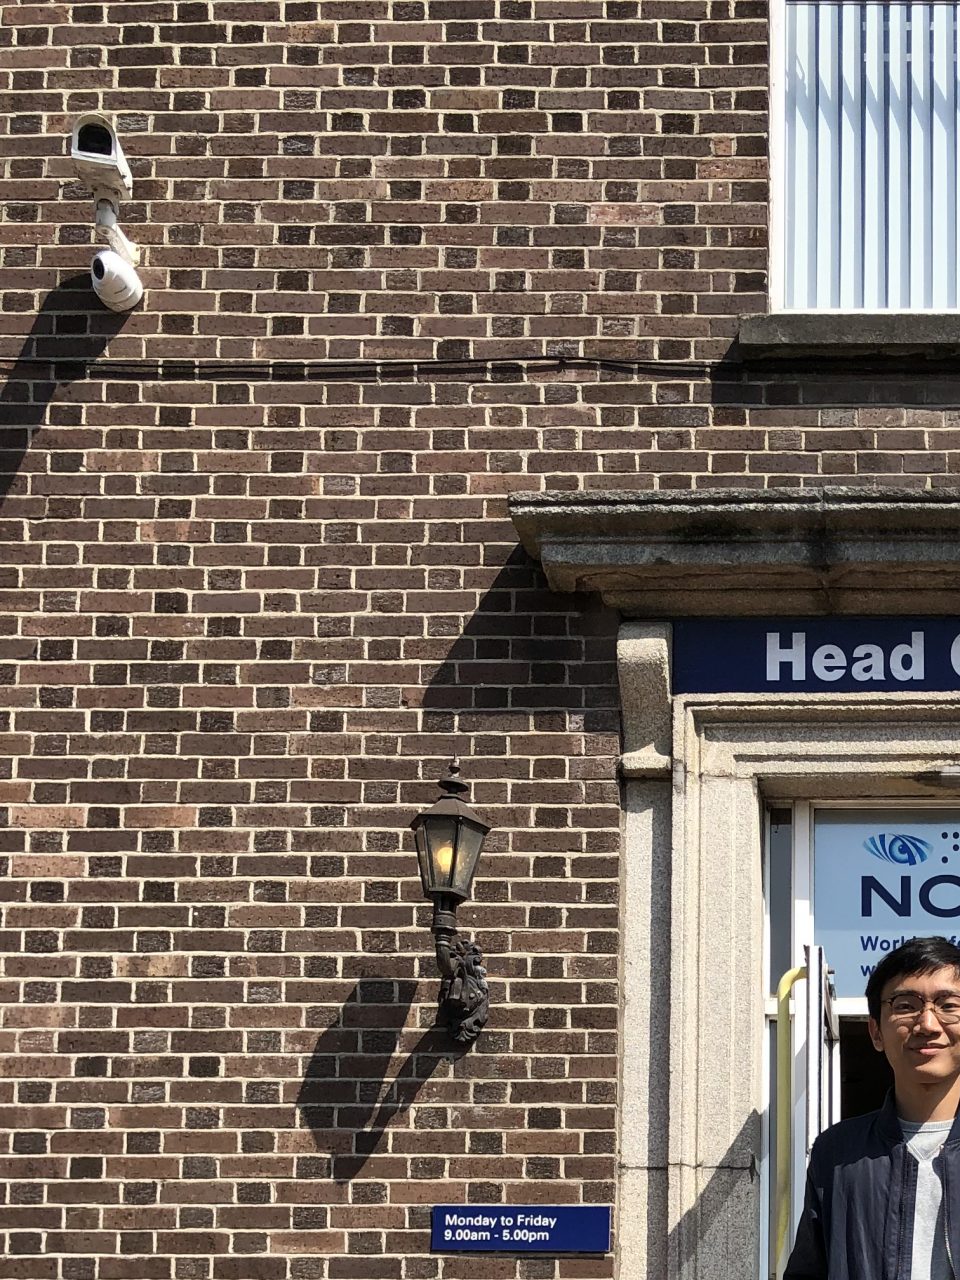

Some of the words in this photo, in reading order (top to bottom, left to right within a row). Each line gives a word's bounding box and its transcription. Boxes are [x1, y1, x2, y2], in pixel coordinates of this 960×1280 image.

[766, 631, 926, 681] Head
[445, 1214, 497, 1228] Monday
[500, 1216, 513, 1226] to
[517, 1214, 557, 1228] Friday
[444, 1229, 490, 1241] 9.00am
[502, 1229, 549, 1243] 5.00pm
